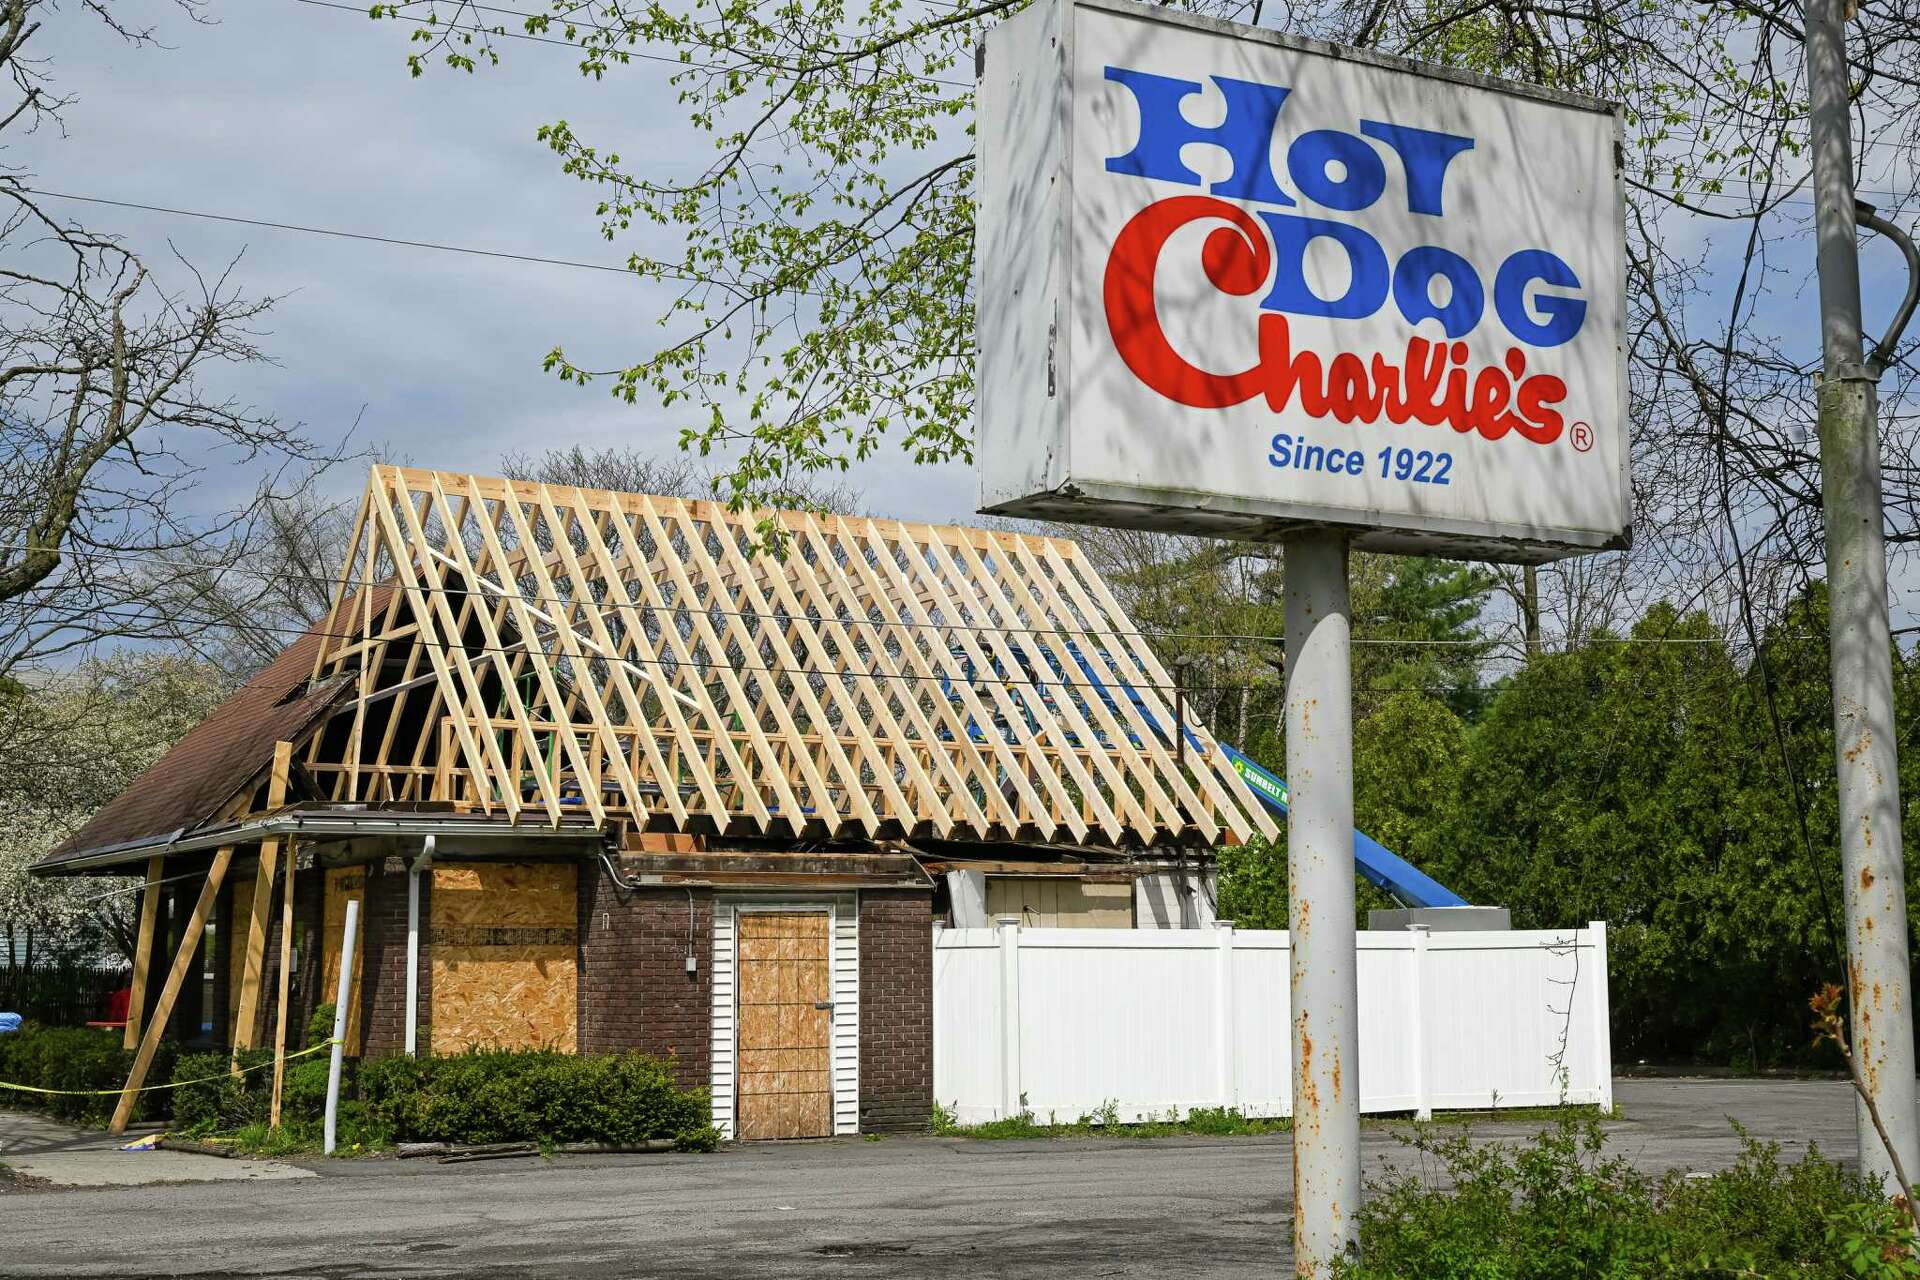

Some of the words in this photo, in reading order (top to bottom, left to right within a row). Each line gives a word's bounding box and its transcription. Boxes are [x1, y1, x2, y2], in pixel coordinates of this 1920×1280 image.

[1103, 195, 1568, 445] Charlie's
[1257, 211, 1587, 348] DOG
[1268, 433, 1364, 475] Since
[1378, 446, 1453, 485] 1922
